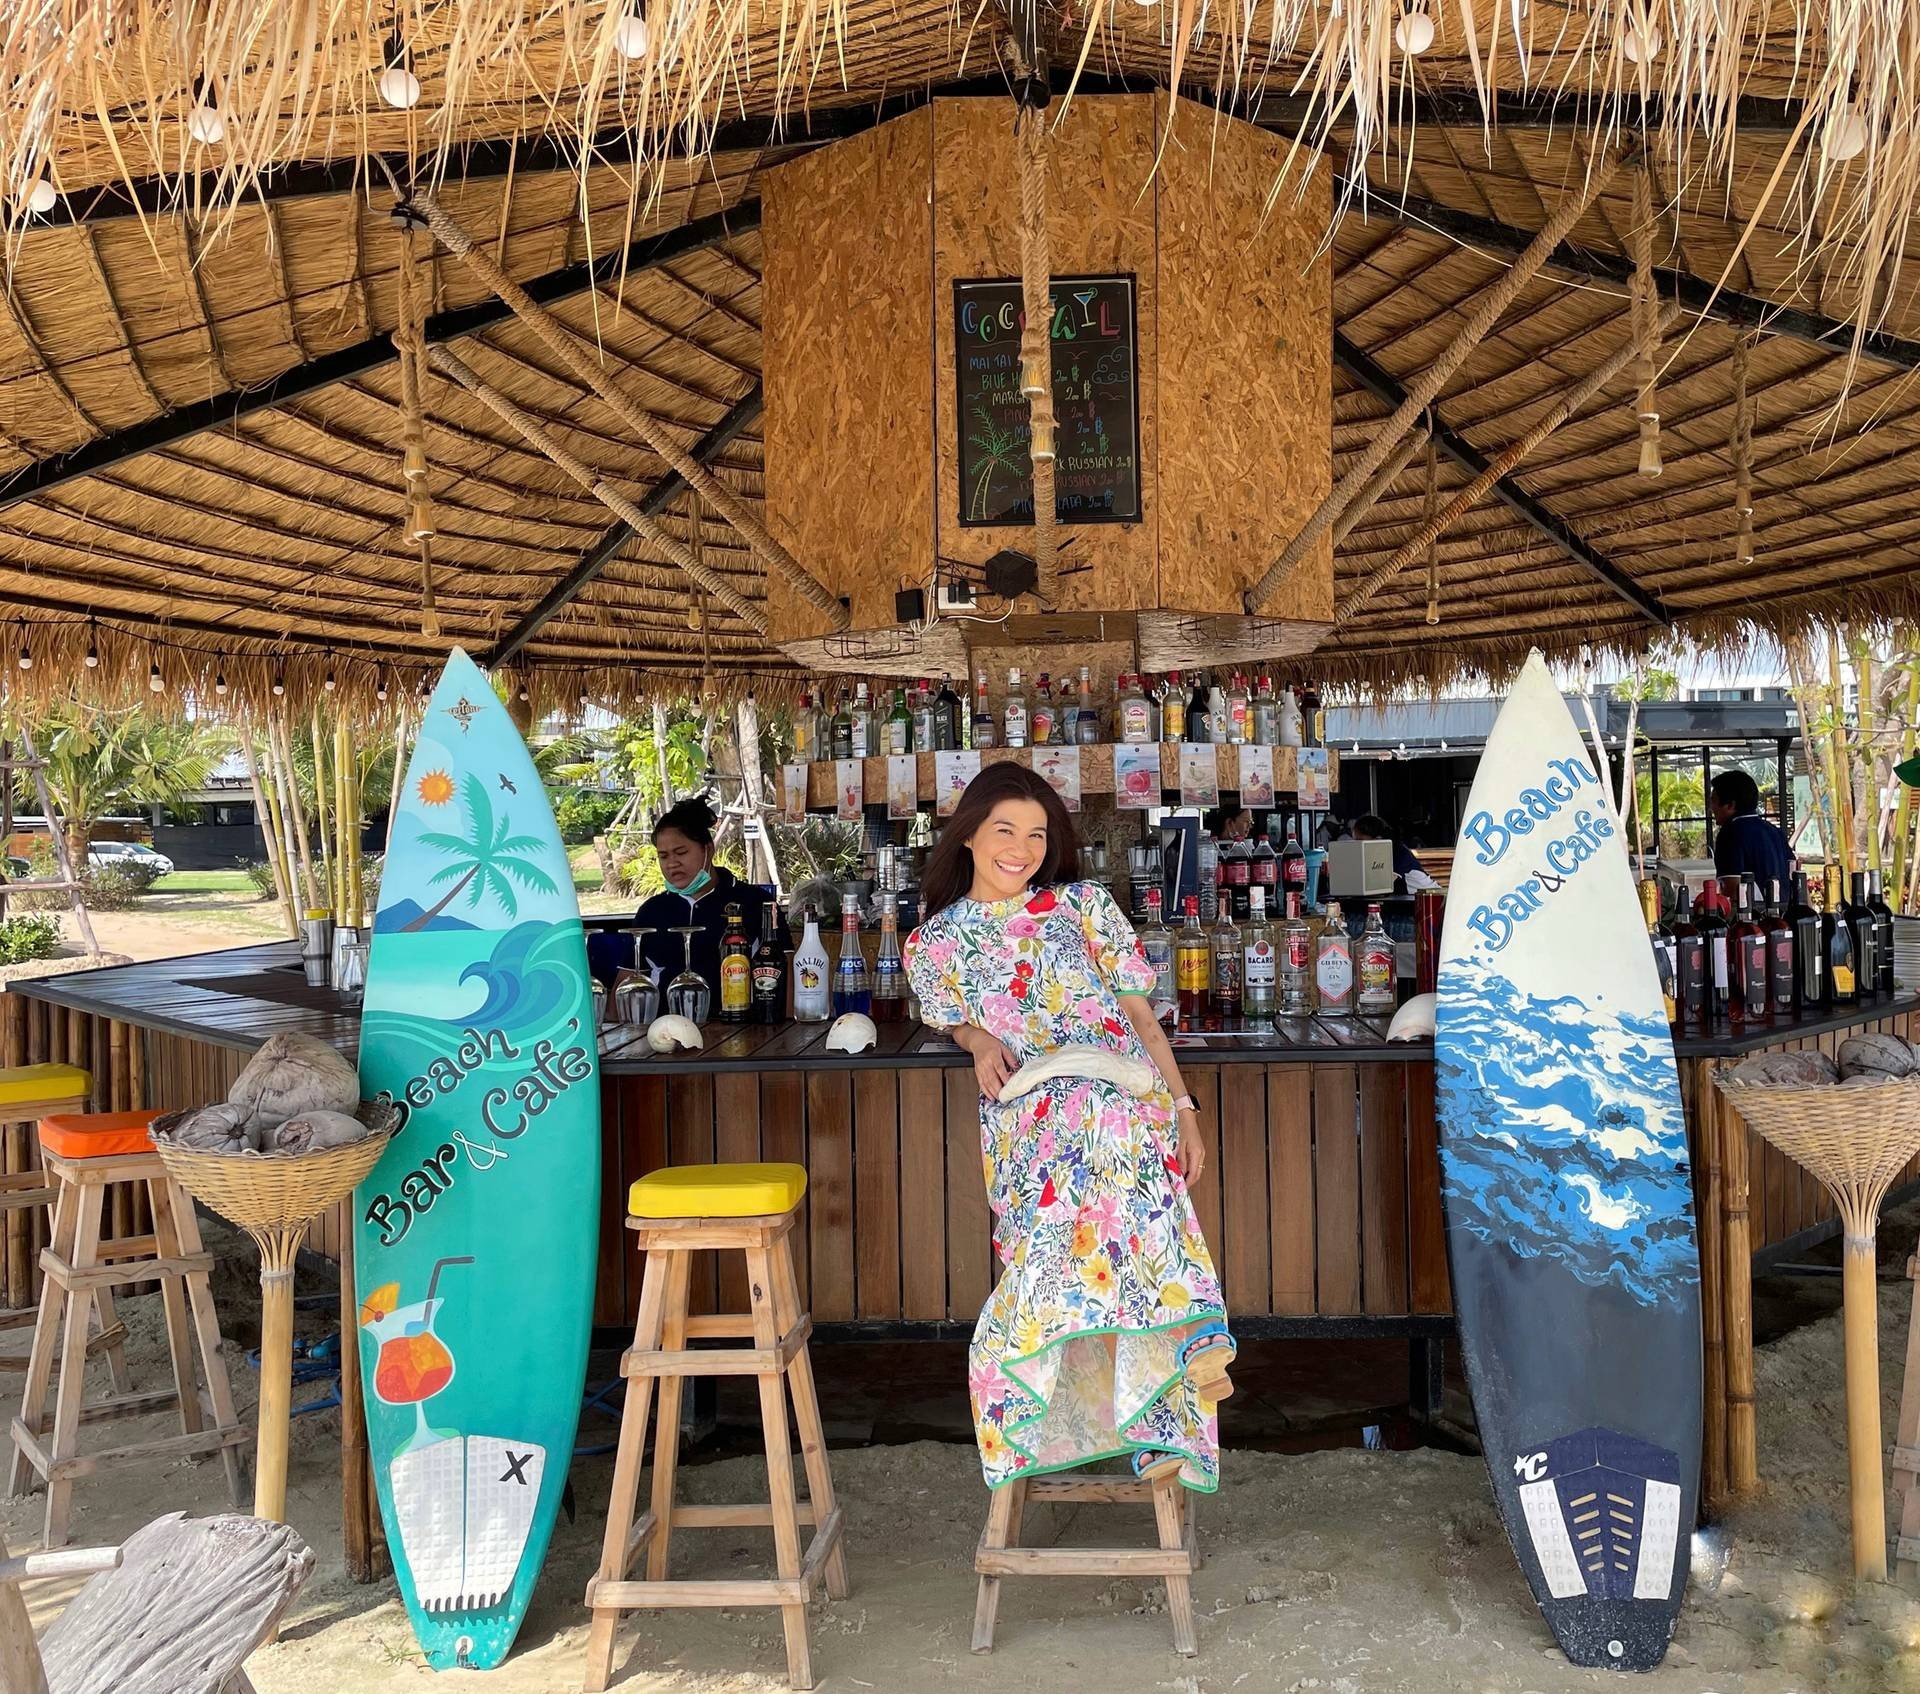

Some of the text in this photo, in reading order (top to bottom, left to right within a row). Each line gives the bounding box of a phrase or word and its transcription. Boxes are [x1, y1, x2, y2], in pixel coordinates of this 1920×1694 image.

[981, 371, 1007, 391] BLUE
[1068, 454, 1114, 471] RUSSIAN
[1464, 758, 1598, 866] Beach
[1467, 879, 1544, 952] Bar
[1532, 870, 1566, 892] &
[795, 957, 826, 970] MALIBU
[365, 1143, 458, 1247] Bar
[452, 1130, 509, 1171] &
